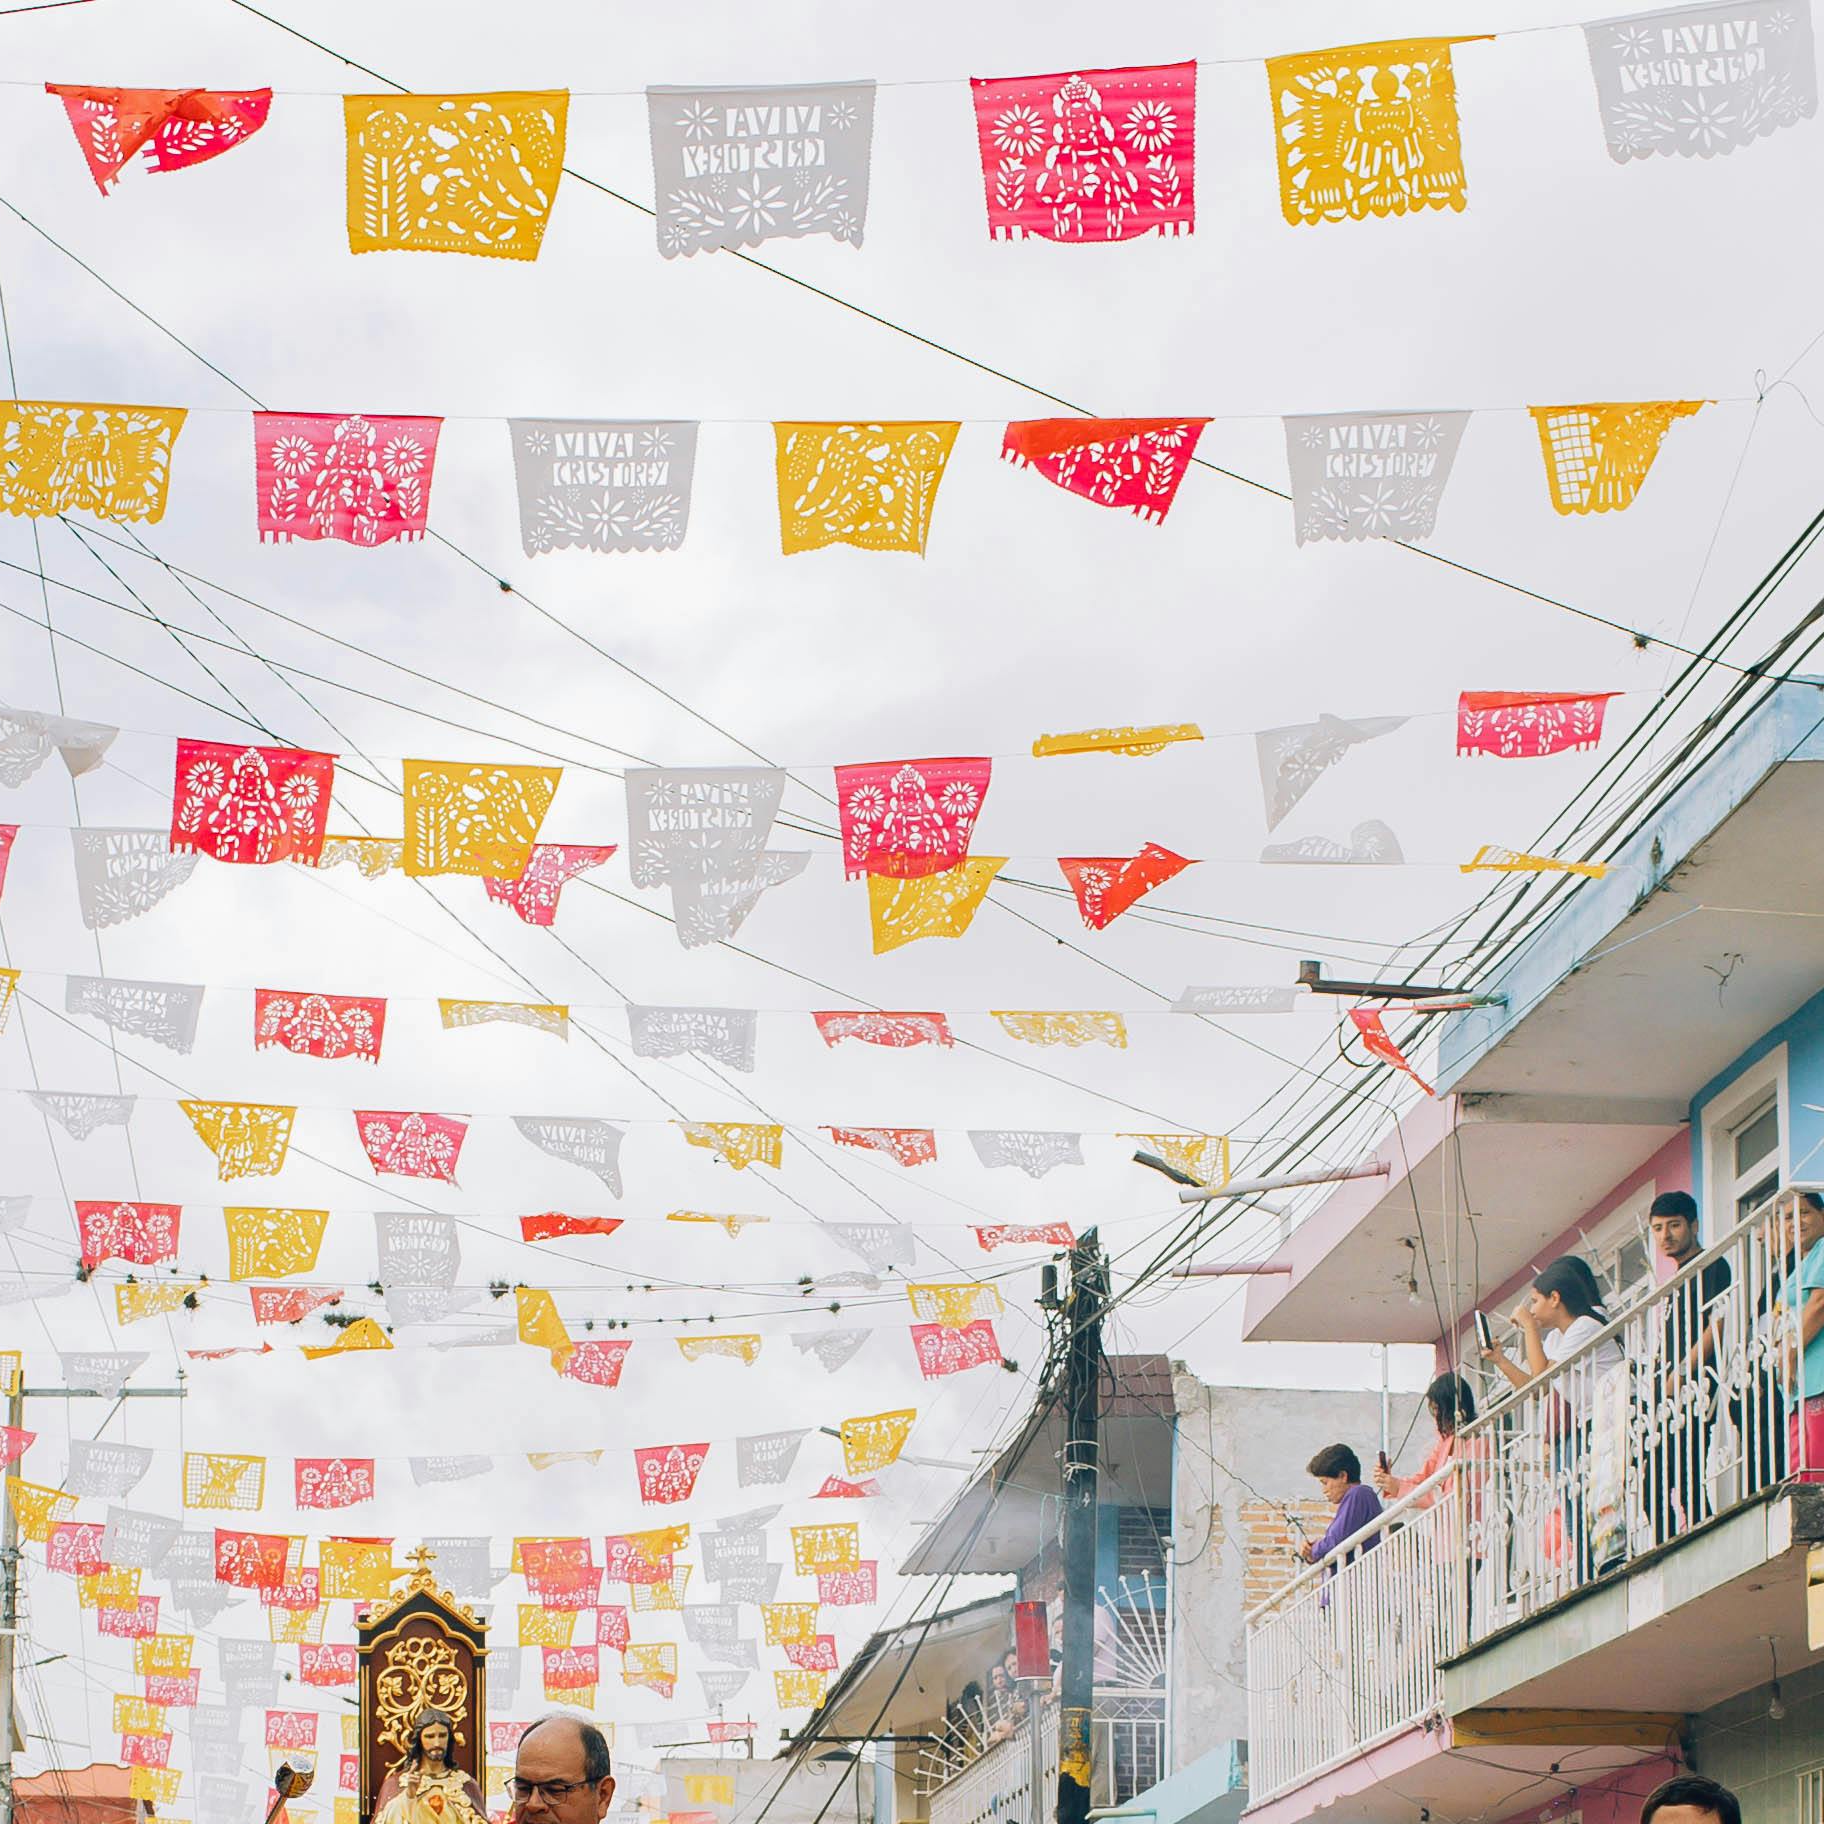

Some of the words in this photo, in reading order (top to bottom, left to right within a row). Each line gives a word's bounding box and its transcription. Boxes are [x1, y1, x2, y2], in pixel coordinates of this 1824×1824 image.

[554, 431, 635, 458] VIVA
[1328, 423, 1408, 450] VIVA
[539, 1124, 586, 1143] VIVA
